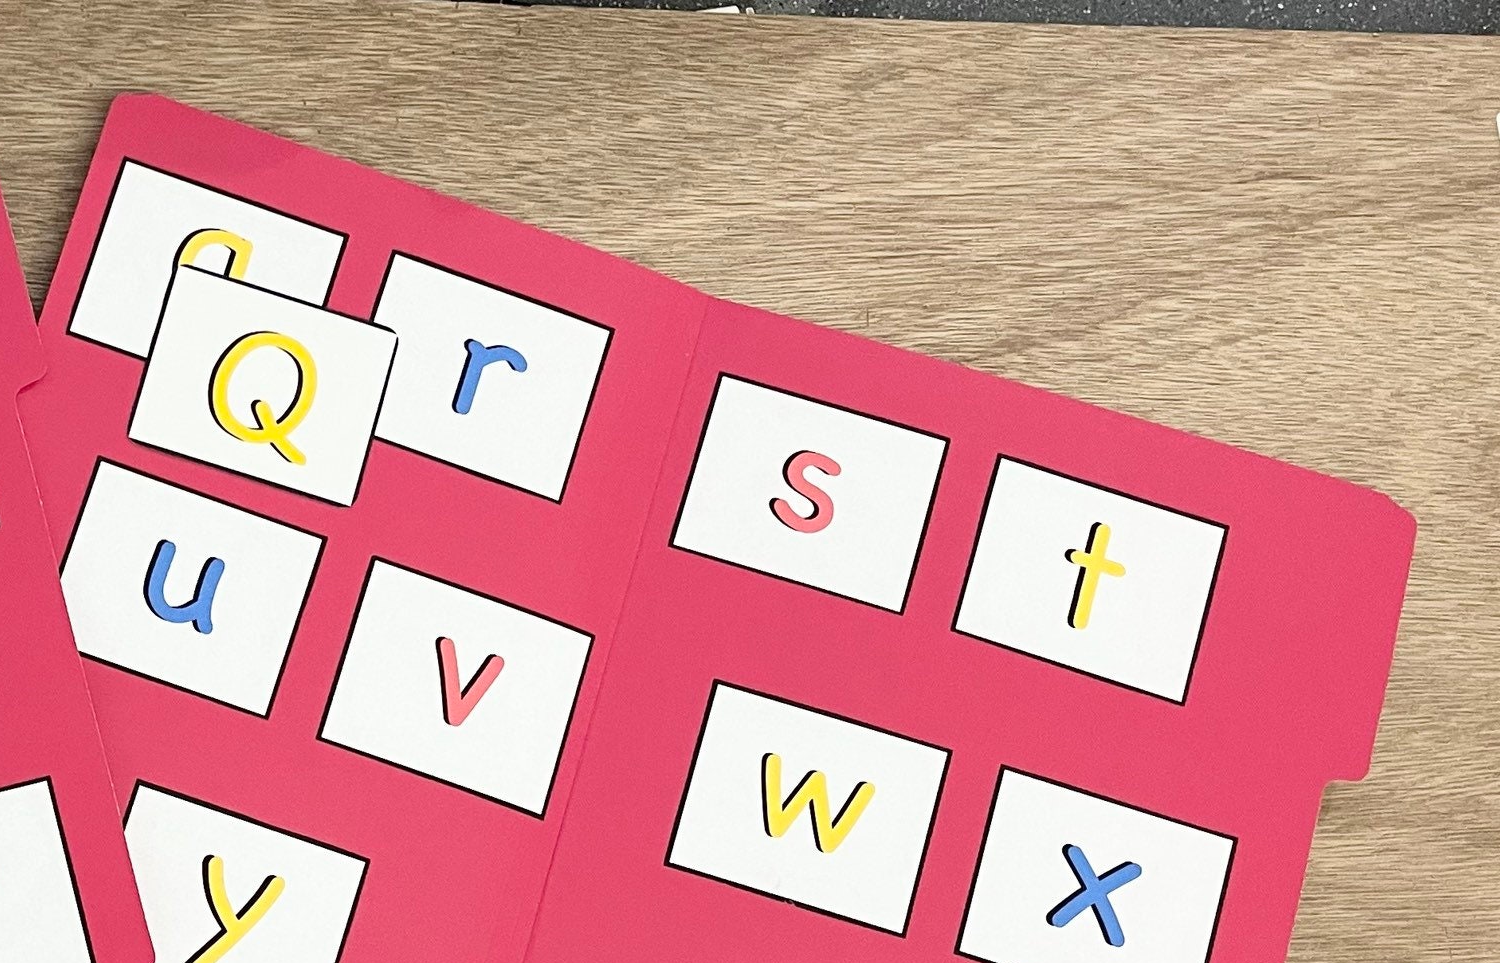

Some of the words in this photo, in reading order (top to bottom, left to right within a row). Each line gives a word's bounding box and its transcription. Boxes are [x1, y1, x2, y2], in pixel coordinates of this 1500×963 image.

[208, 331, 318, 466] Q
[452, 339, 527, 414] r
[769, 450, 841, 533] s
[143, 539, 225, 634] u
[1065, 522, 1126, 630] t
[435, 637, 504, 726] v
[761, 753, 876, 854] w
[1046, 844, 1142, 947] x
